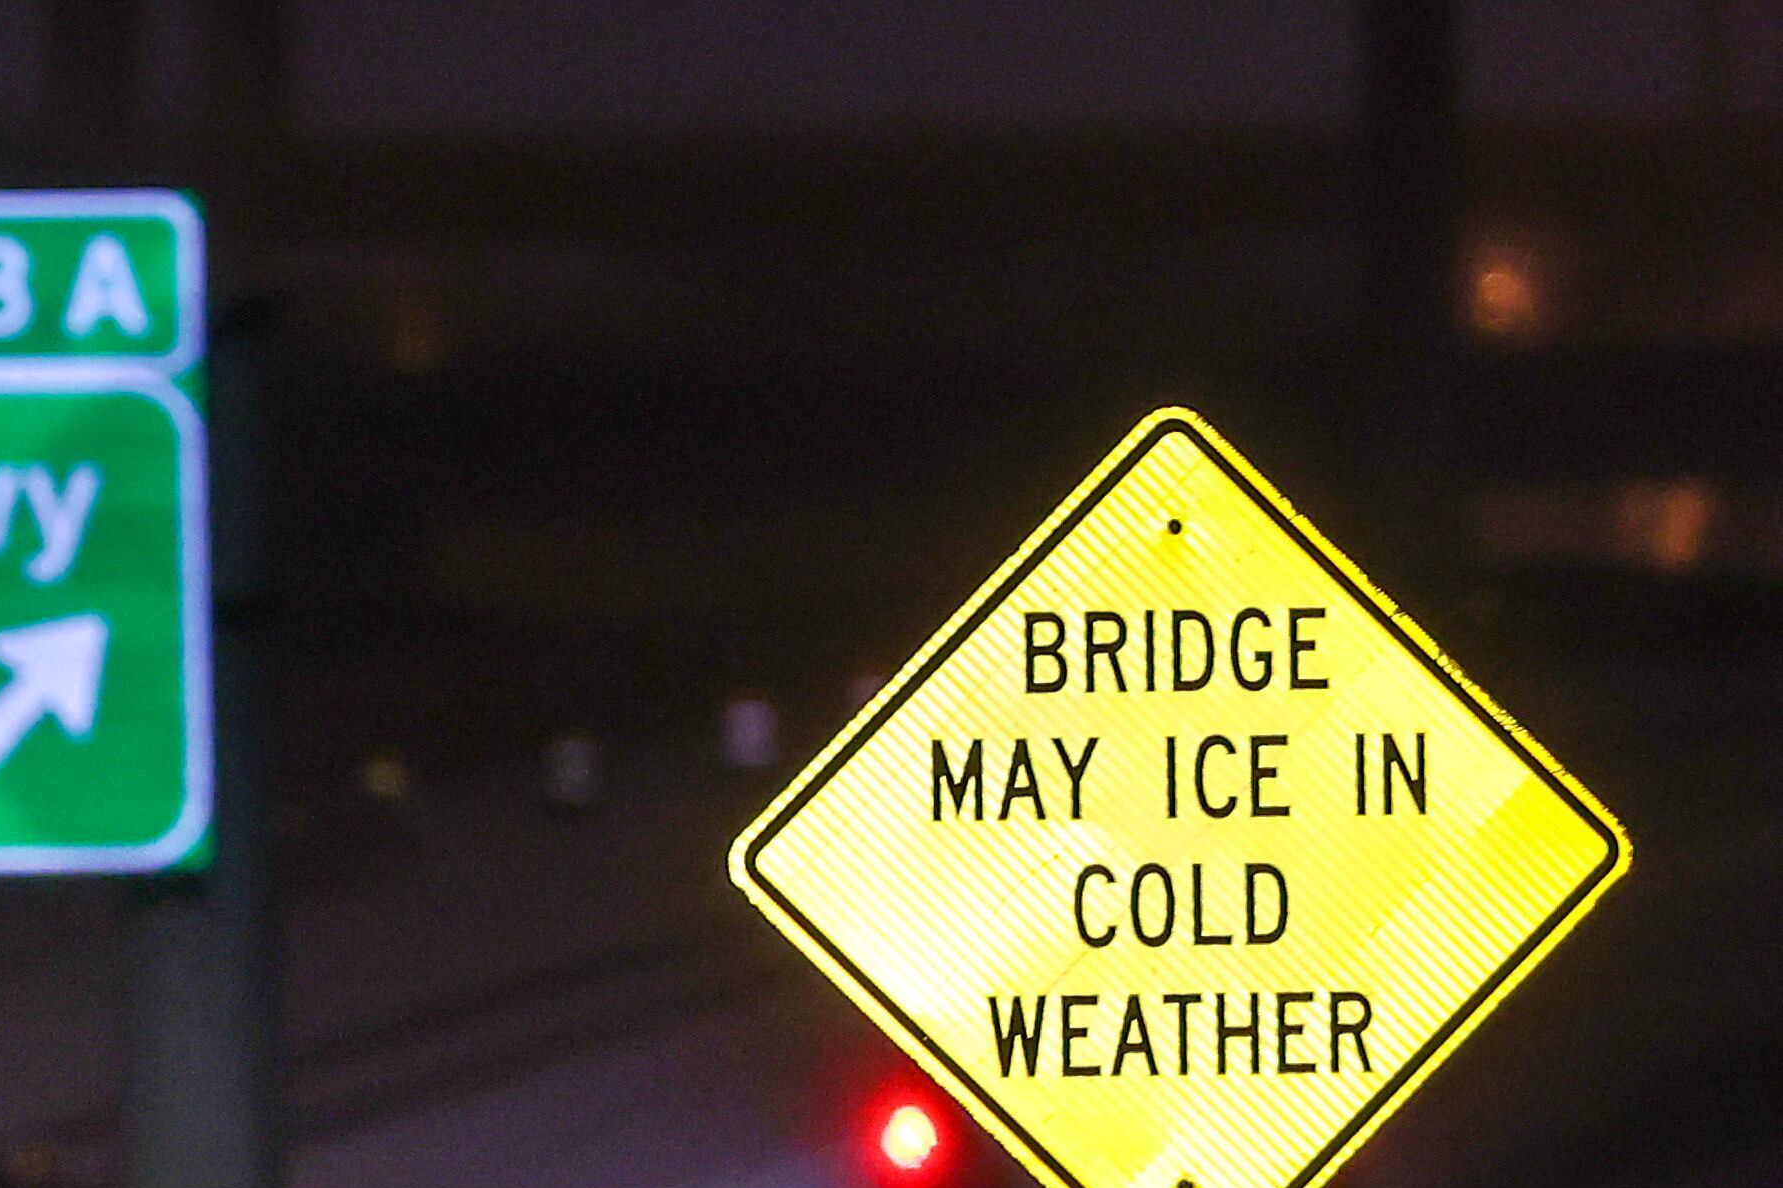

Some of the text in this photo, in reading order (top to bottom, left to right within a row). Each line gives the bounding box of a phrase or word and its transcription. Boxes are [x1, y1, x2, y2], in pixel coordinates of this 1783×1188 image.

[66, 236, 148, 334] A
[1024, 607, 1329, 694] BRIDGE
[931, 732, 1427, 821] MAY ICE IN
[1074, 863, 1289, 948] COLD
[988, 992, 1373, 1077] WEATHER
